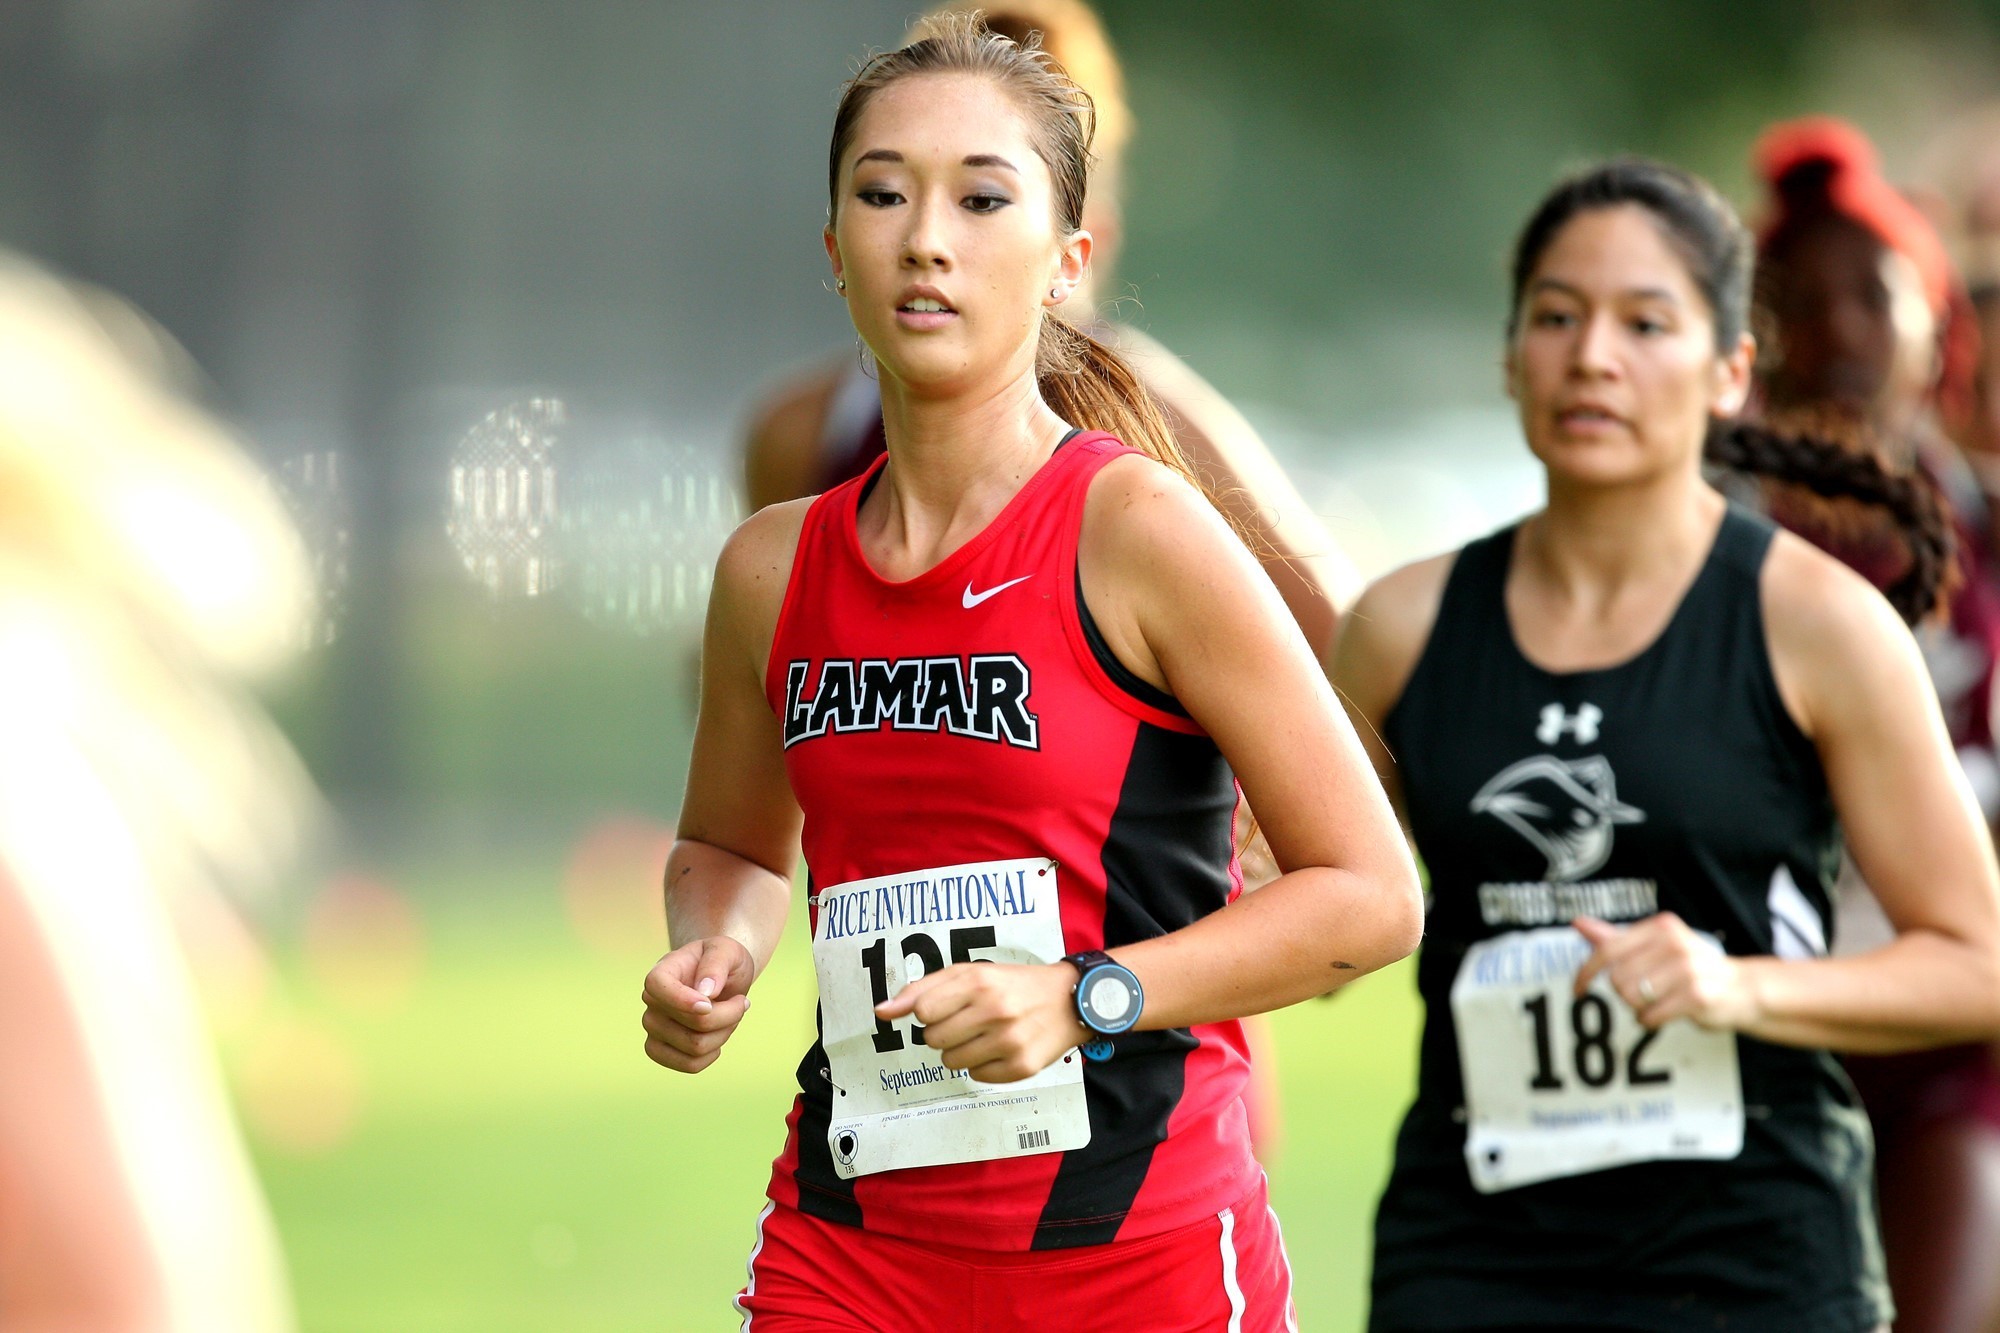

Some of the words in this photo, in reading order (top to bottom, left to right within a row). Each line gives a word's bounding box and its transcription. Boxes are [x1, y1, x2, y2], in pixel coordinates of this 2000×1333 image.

[784, 652, 1041, 752] LAMAR
[825, 889, 870, 940] RICE
[873, 869, 1036, 932] INVITATIONAL
[1524, 992, 1672, 1091] 182
[879, 1061, 945, 1096] September
[960, 1102, 978, 1111] UNTIL
[978, 1101, 986, 1109] IN
[987, 1098, 1011, 1107] FINISH
[1016, 1124, 1028, 1132] 135
[844, 1164, 855, 1174] 135
